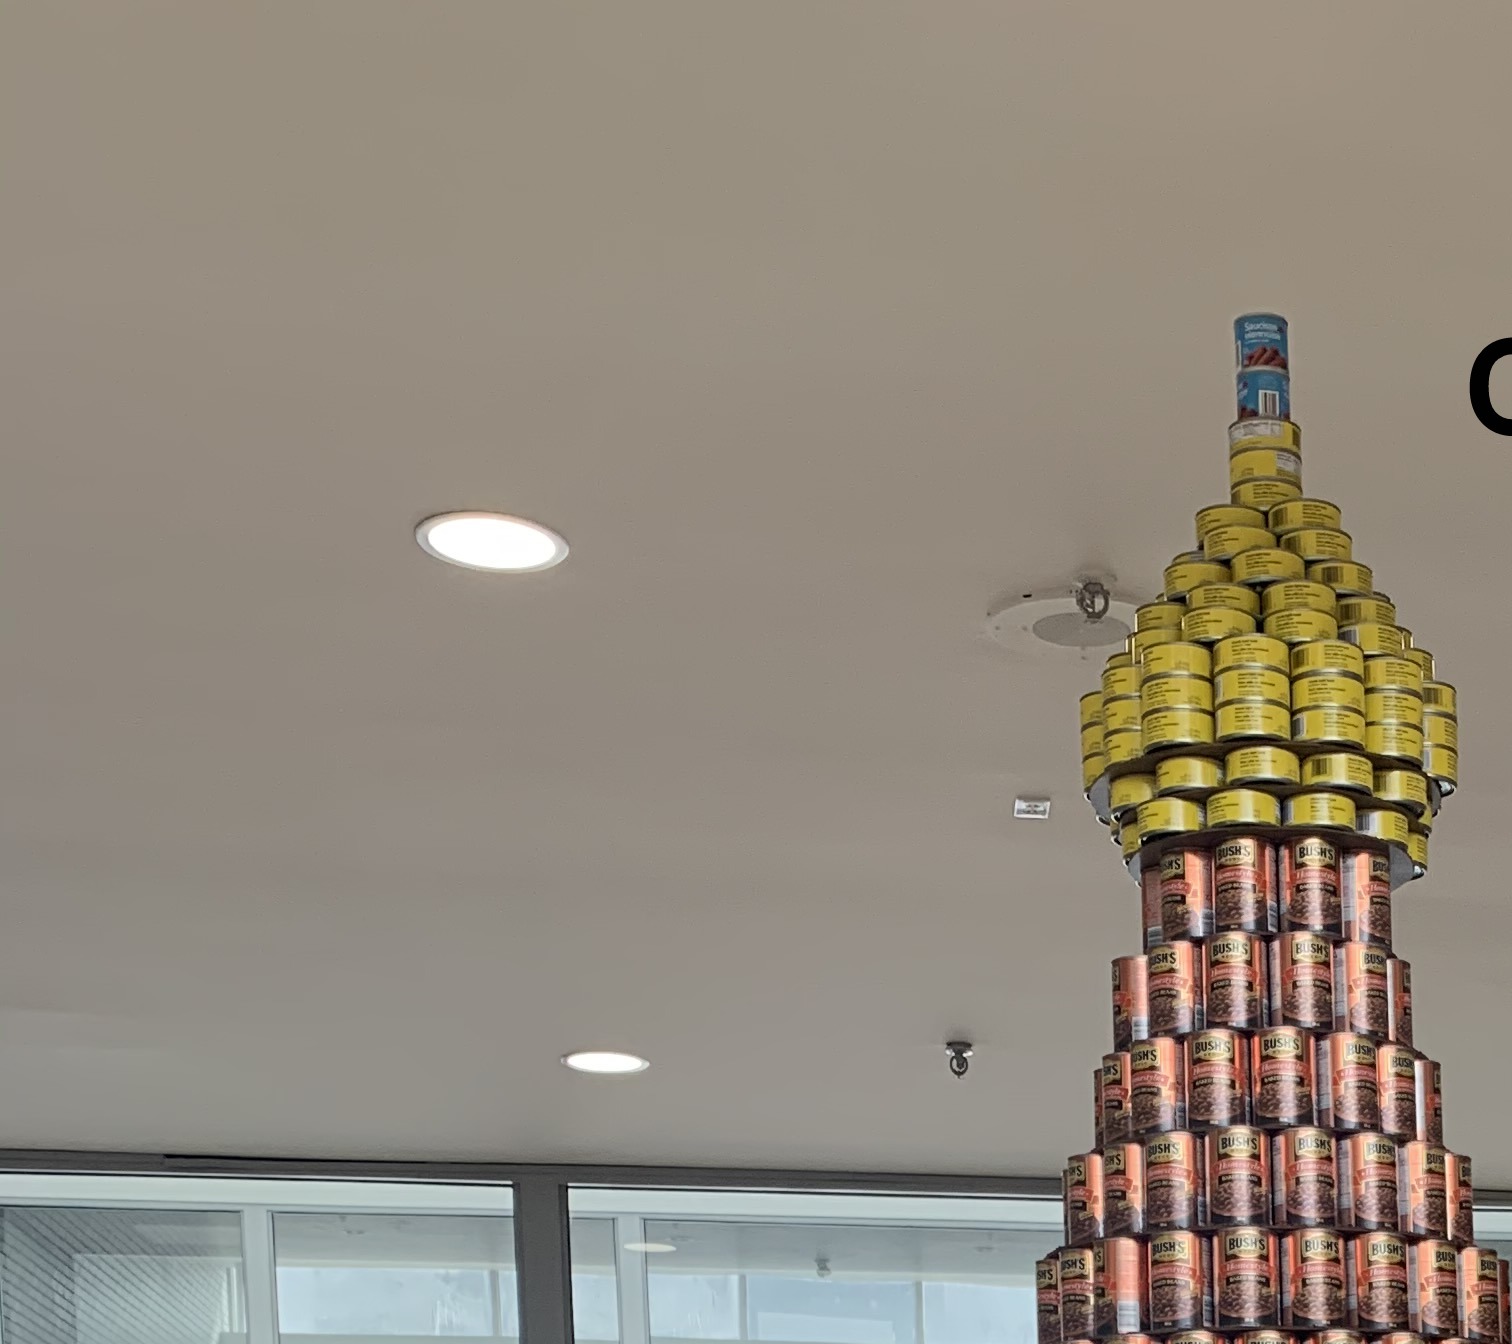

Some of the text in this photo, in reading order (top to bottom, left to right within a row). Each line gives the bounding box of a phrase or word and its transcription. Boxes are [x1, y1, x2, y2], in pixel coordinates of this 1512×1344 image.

[1216, 846, 1250, 859] BUSH'S
[1299, 846, 1334, 859] BUSH'S
[1212, 944, 1248, 956] BUSH'S
[1263, 1037, 1299, 1051] BUSH'S
[1221, 1135, 1258, 1152] BUSH'S
[1229, 1236, 1266, 1252] BUSH'S
